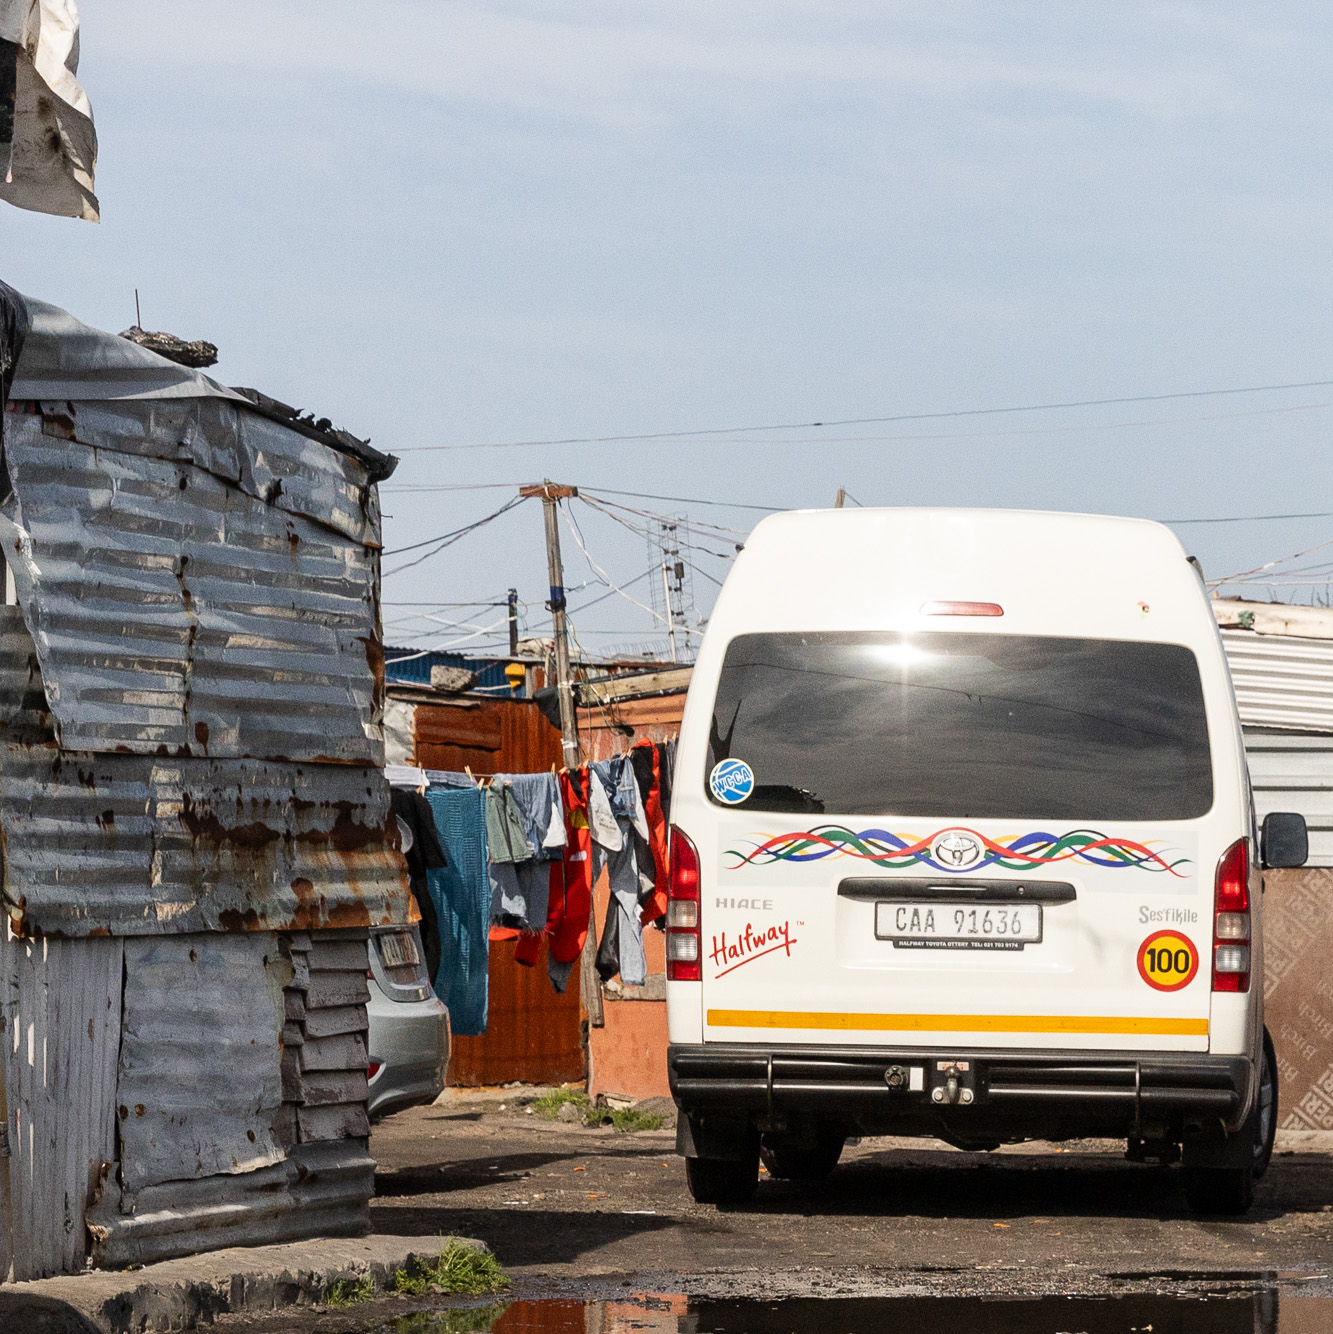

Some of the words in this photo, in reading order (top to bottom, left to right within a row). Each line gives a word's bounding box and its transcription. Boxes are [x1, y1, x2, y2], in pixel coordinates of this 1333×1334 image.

[715, 897, 774, 910] HIACE
[895, 907, 936, 933] CAA
[954, 910, 1022, 935] 91636
[709, 921, 797, 967] Halfway
[1147, 948, 1190, 974] 100
[1276, 1022, 1318, 1060] Birch
